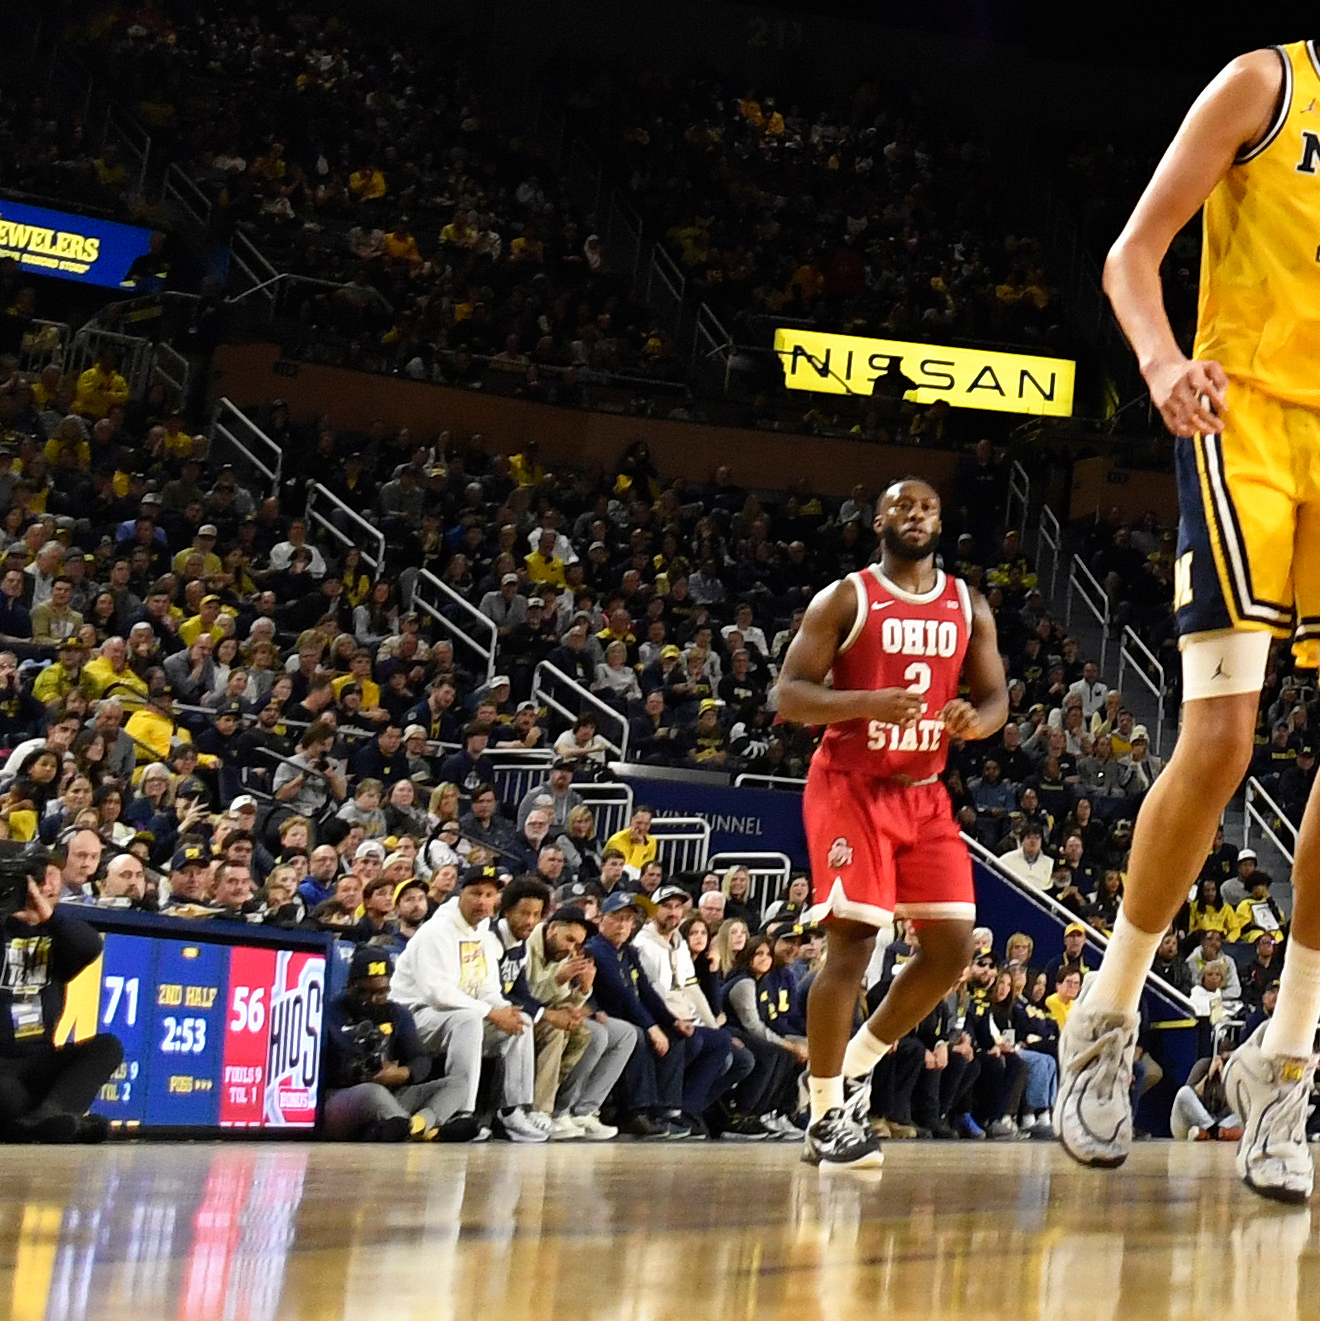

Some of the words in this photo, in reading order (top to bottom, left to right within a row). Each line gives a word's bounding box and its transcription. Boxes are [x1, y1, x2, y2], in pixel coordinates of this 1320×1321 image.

[881, 617, 958, 659] OHIO
[866, 718, 946, 752] STATE
[694, 811, 763, 836] TUNNEL
[104, 976, 139, 1027] 71
[184, 985, 218, 1009] HALF
[230, 985, 265, 1033] 56
[160, 1016, 207, 1054] 2:53
